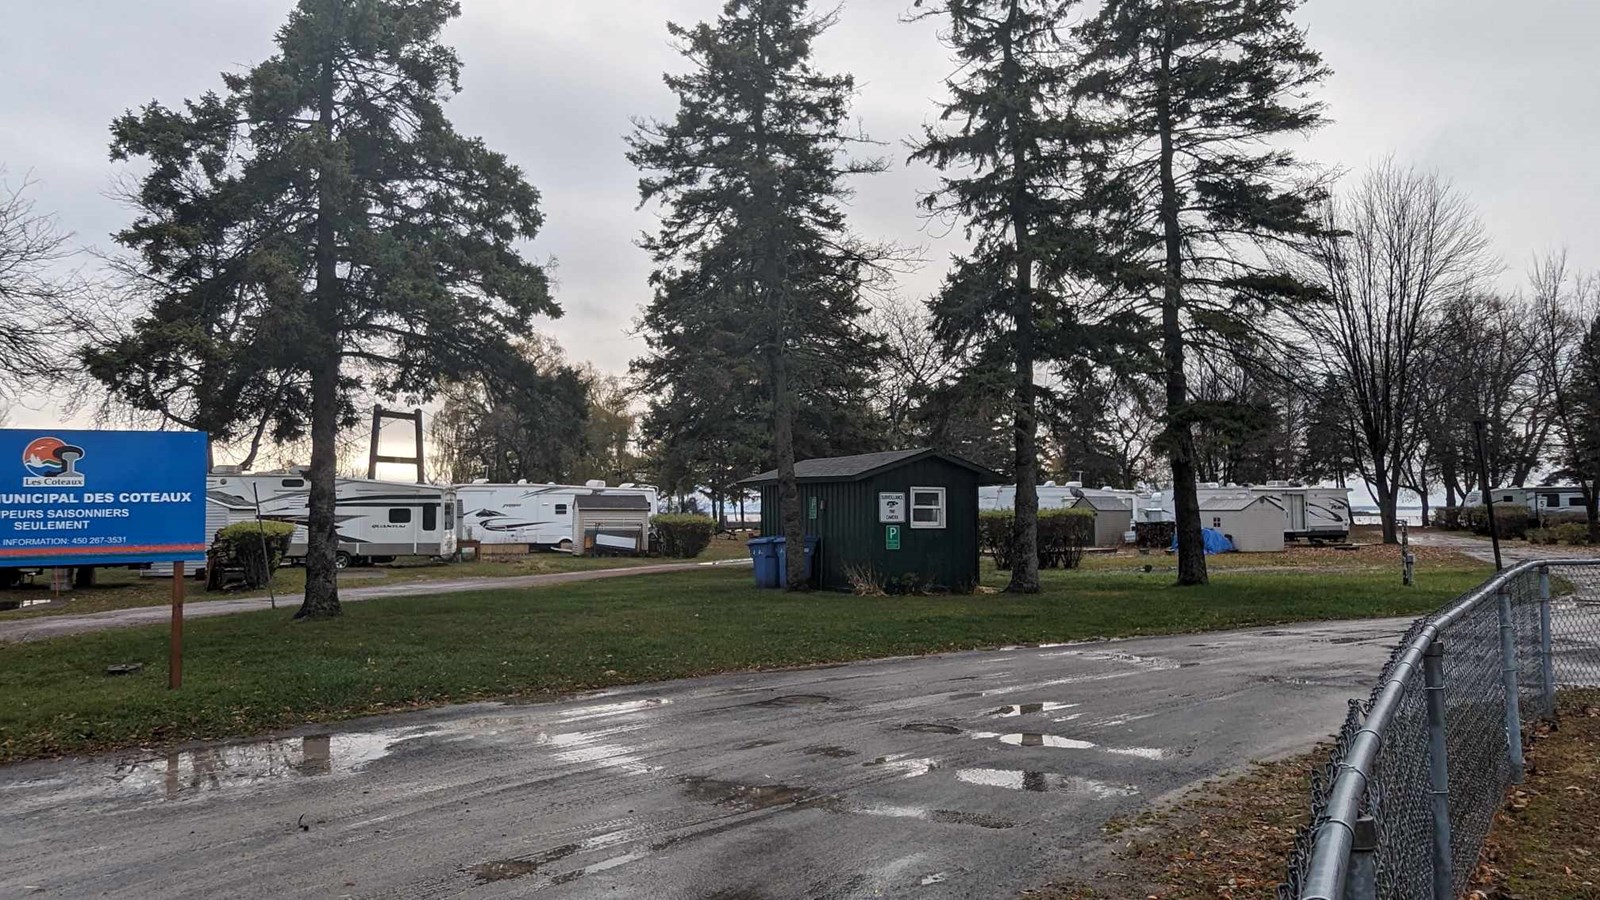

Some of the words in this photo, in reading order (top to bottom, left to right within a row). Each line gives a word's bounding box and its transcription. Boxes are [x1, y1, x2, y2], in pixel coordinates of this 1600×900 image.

[25, 478, 41, 486] Les
[44, 478, 82, 486] Coteaux
[0, 493, 79, 504] UNICIPAL
[83, 492, 115, 503] DES
[119, 492, 192, 503] COTEAUX
[47, 508, 130, 518] SAISONNIERS
[14, 520, 90, 531] SEULEMENT
[890, 527, 897, 539] P
[2, 537, 70, 546] INFORMATION:
[71, 537, 88, 545] 450
[89, 536, 127, 545] 267-3531
